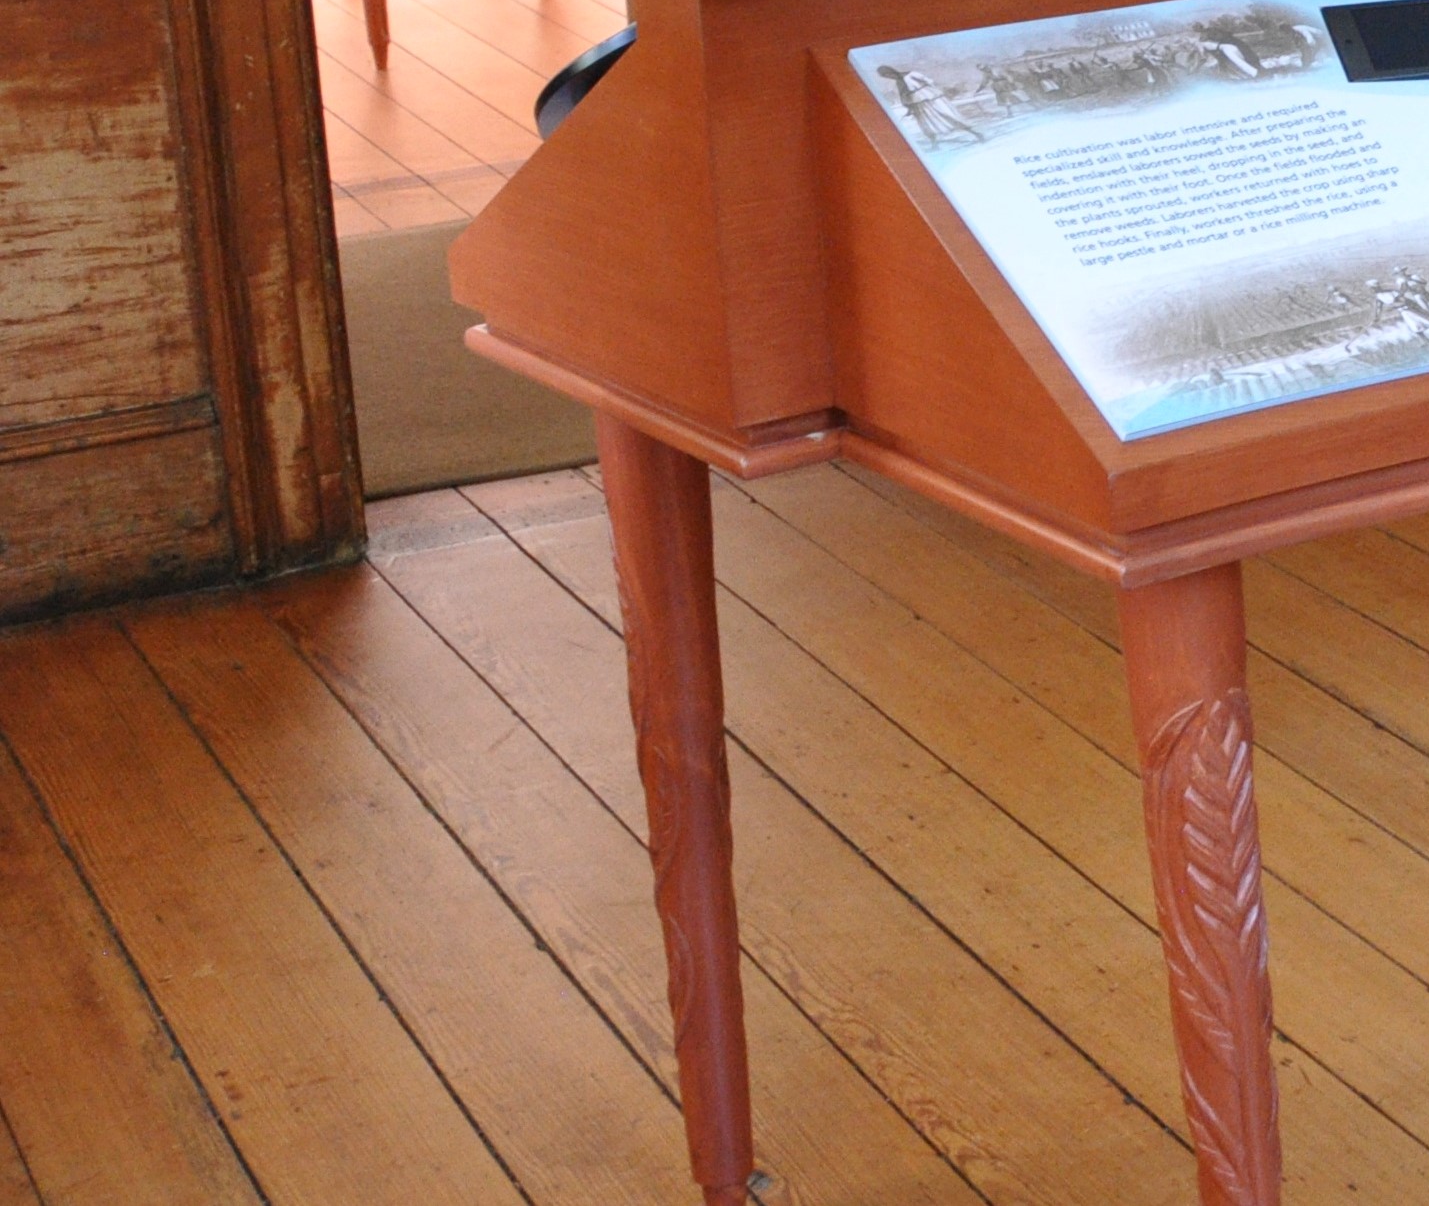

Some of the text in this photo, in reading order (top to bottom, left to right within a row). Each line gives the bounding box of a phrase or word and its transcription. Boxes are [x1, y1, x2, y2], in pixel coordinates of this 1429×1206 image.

[1013, 101, 1319, 165] Rice cultivation was labor intensive and required
